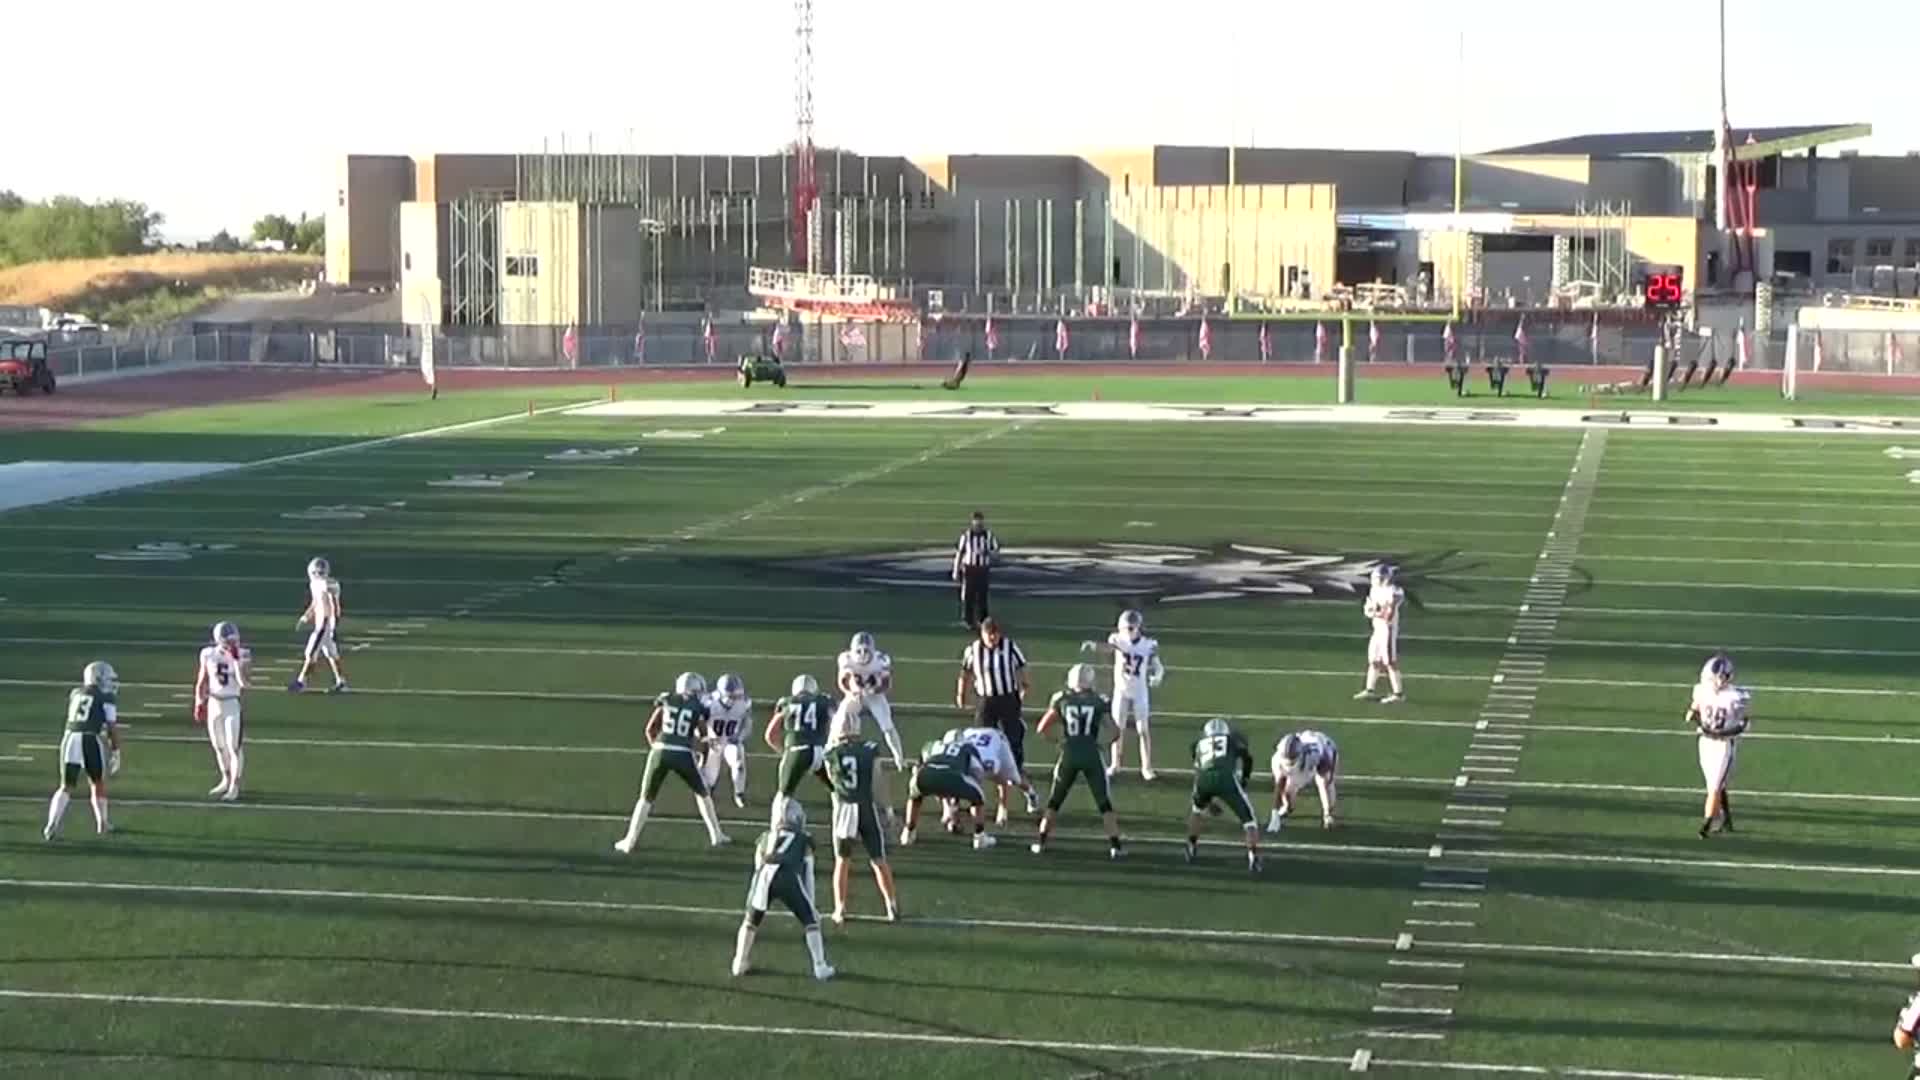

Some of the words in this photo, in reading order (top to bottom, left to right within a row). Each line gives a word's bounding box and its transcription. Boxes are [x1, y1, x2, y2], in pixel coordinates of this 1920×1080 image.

[1647, 274, 1679, 300] 25
[217, 663, 229, 686] 5
[662, 705, 692, 736] 56
[788, 702, 817, 732] 74
[1065, 705, 1095, 736] 67
[842, 755, 858, 788] 3
[777, 830, 796, 853] 7
